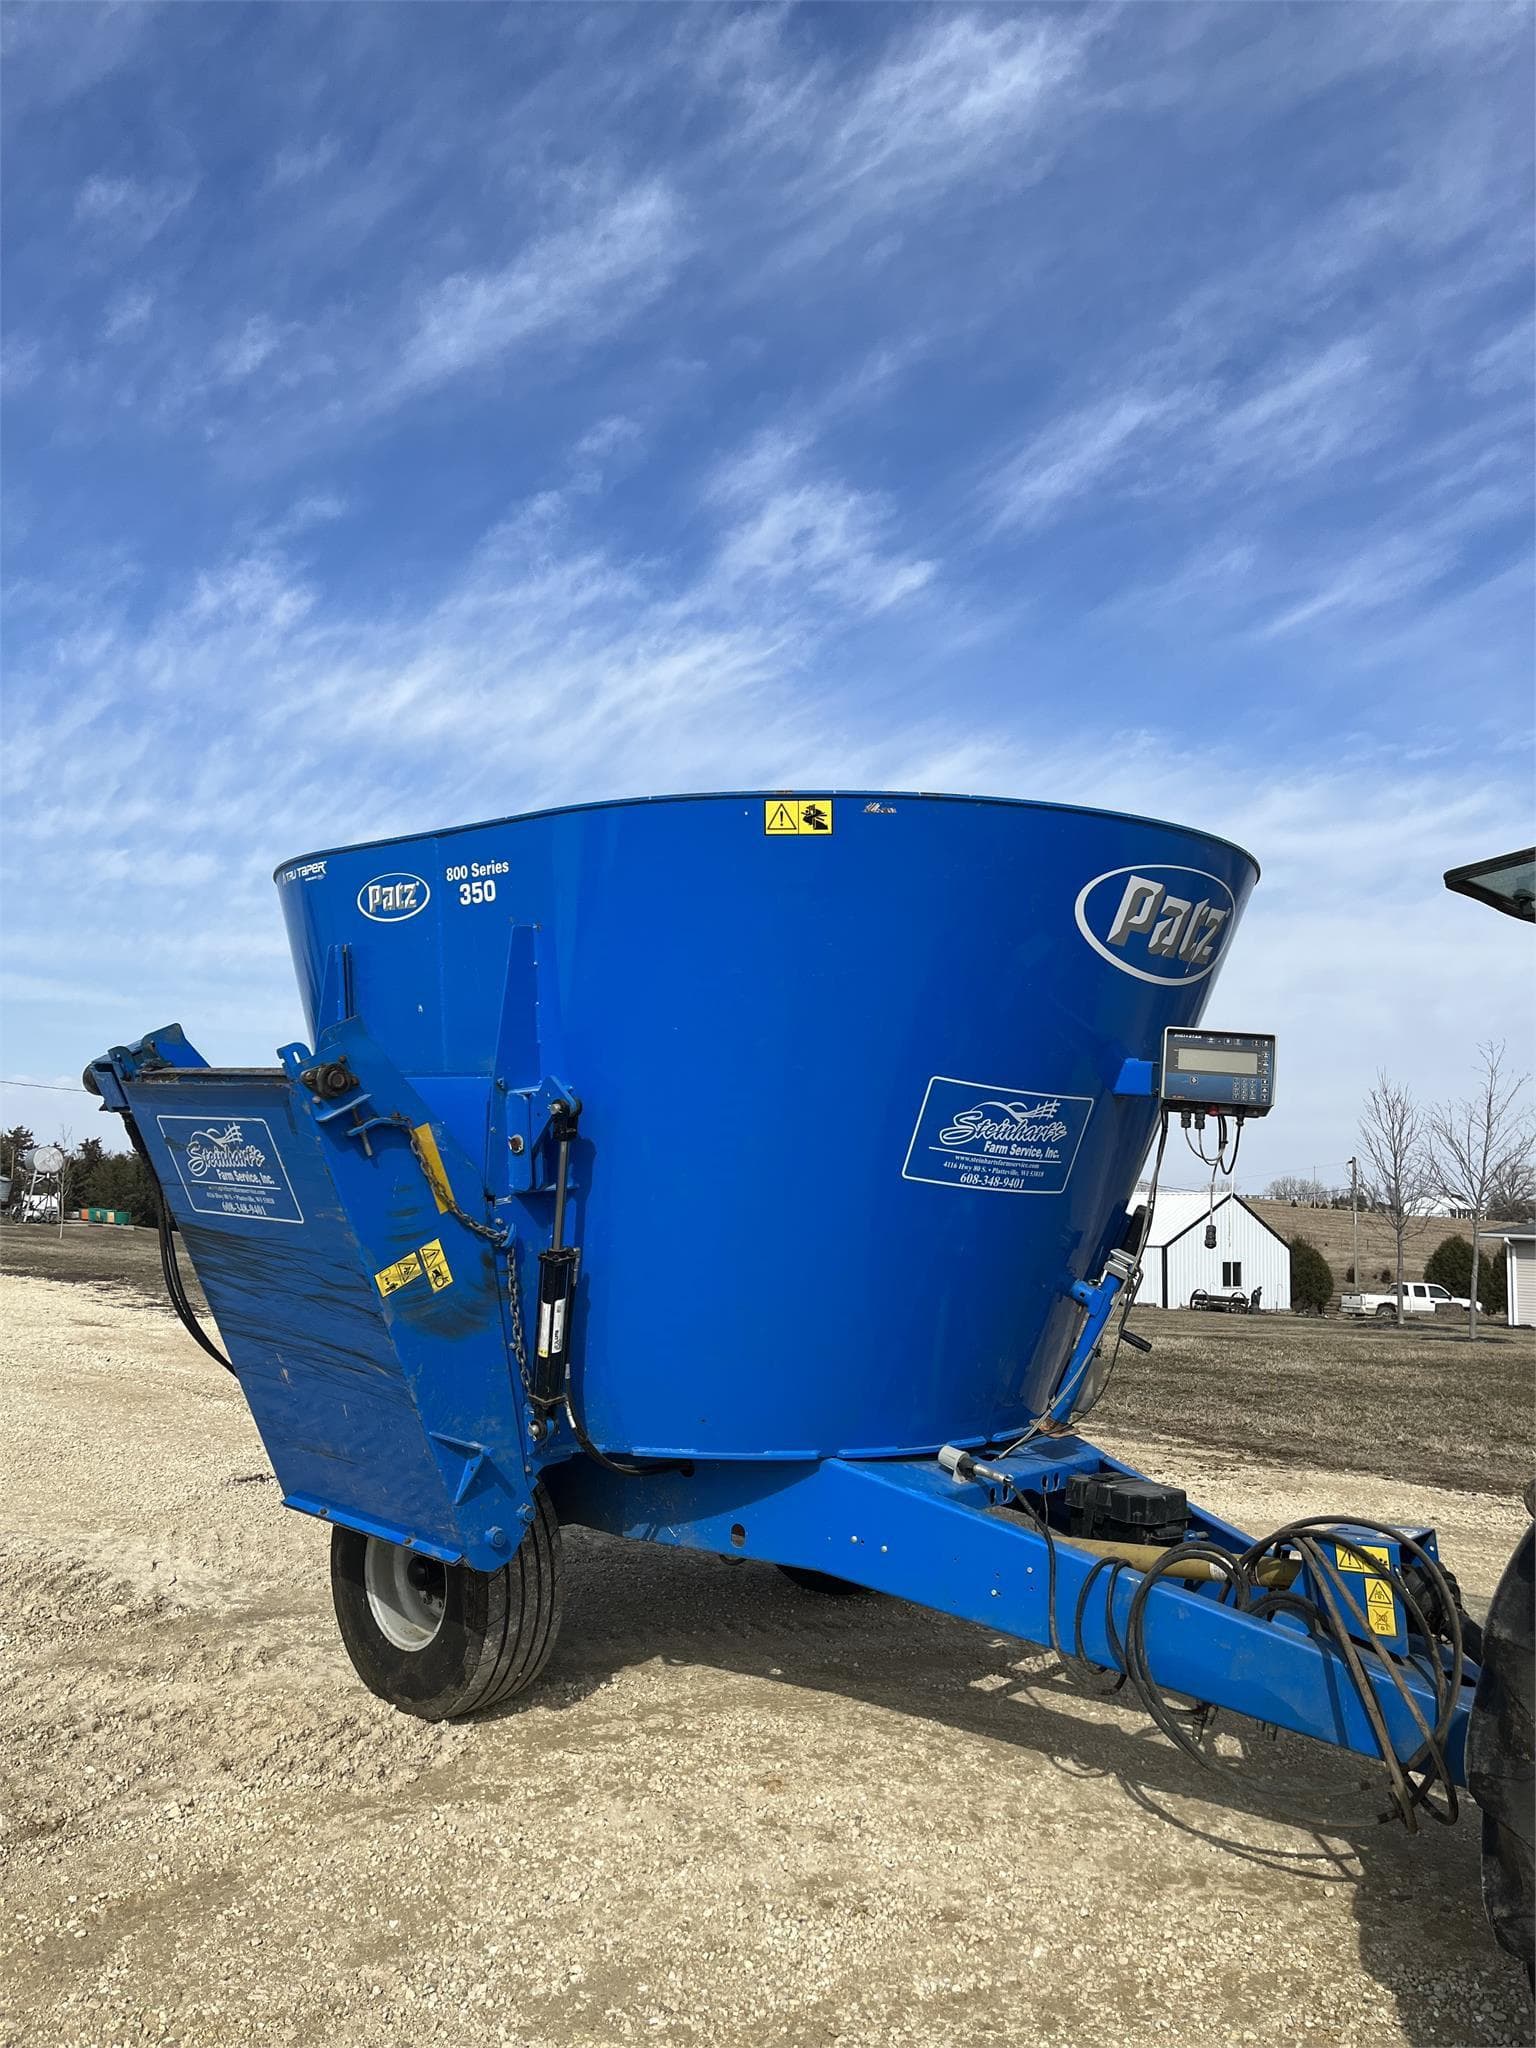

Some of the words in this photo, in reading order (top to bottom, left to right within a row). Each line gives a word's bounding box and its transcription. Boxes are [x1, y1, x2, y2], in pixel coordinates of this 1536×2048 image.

[446, 865, 468, 881] 800
[471, 860, 509, 877] Series
[368, 882, 417, 912] Patz
[459, 880, 496, 905] 350
[1106, 874, 1226, 964] Patz
[984, 1140, 1008, 1155] Farm
[1009, 1143, 1043, 1159] Service,
[1045, 1147, 1060, 1159] Inc.
[216, 1168, 234, 1181] Farm
[233, 1170, 262, 1185] Service,
[960, 1172, 1025, 1189] 608-348-9401
